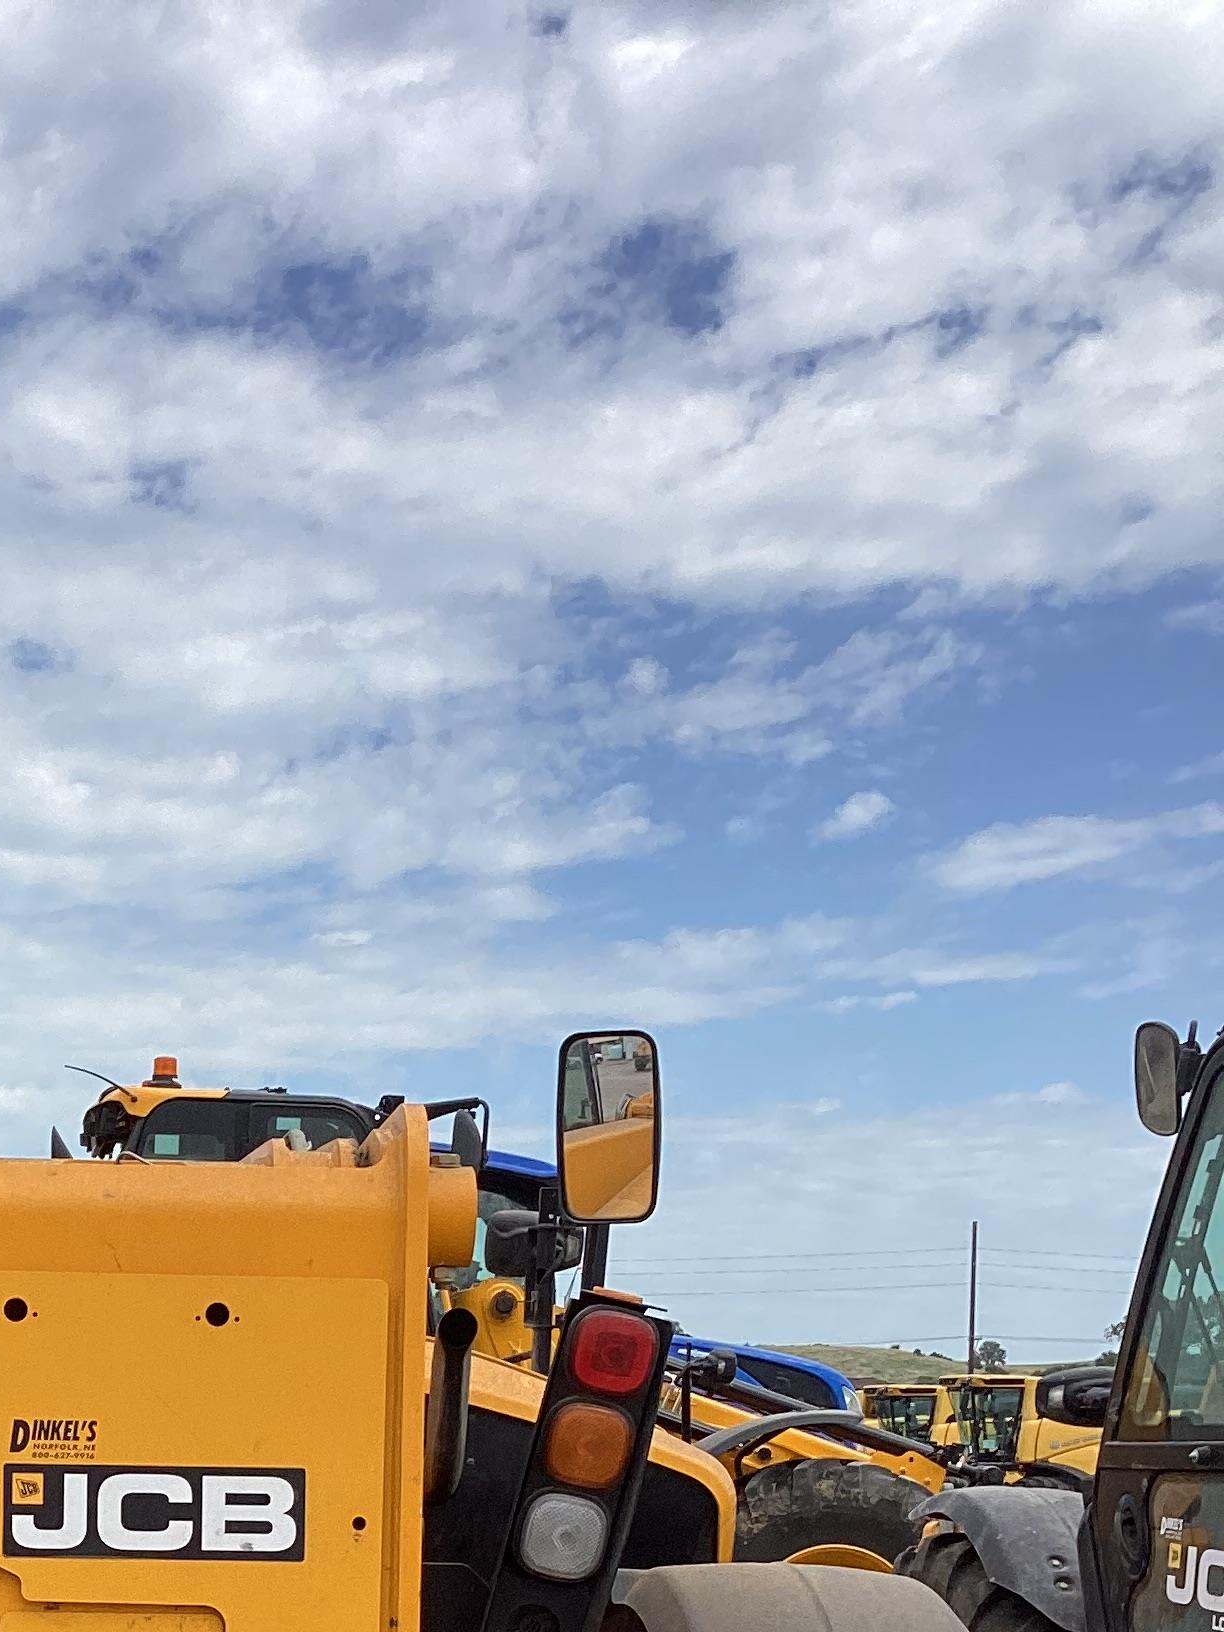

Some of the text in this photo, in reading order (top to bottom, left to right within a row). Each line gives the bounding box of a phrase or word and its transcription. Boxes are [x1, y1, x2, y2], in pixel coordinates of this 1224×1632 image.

[10, 1418, 98, 1452] DINKEL'S
[83, 1444, 96, 1452] NE
[12, 1473, 297, 1552] JCB
